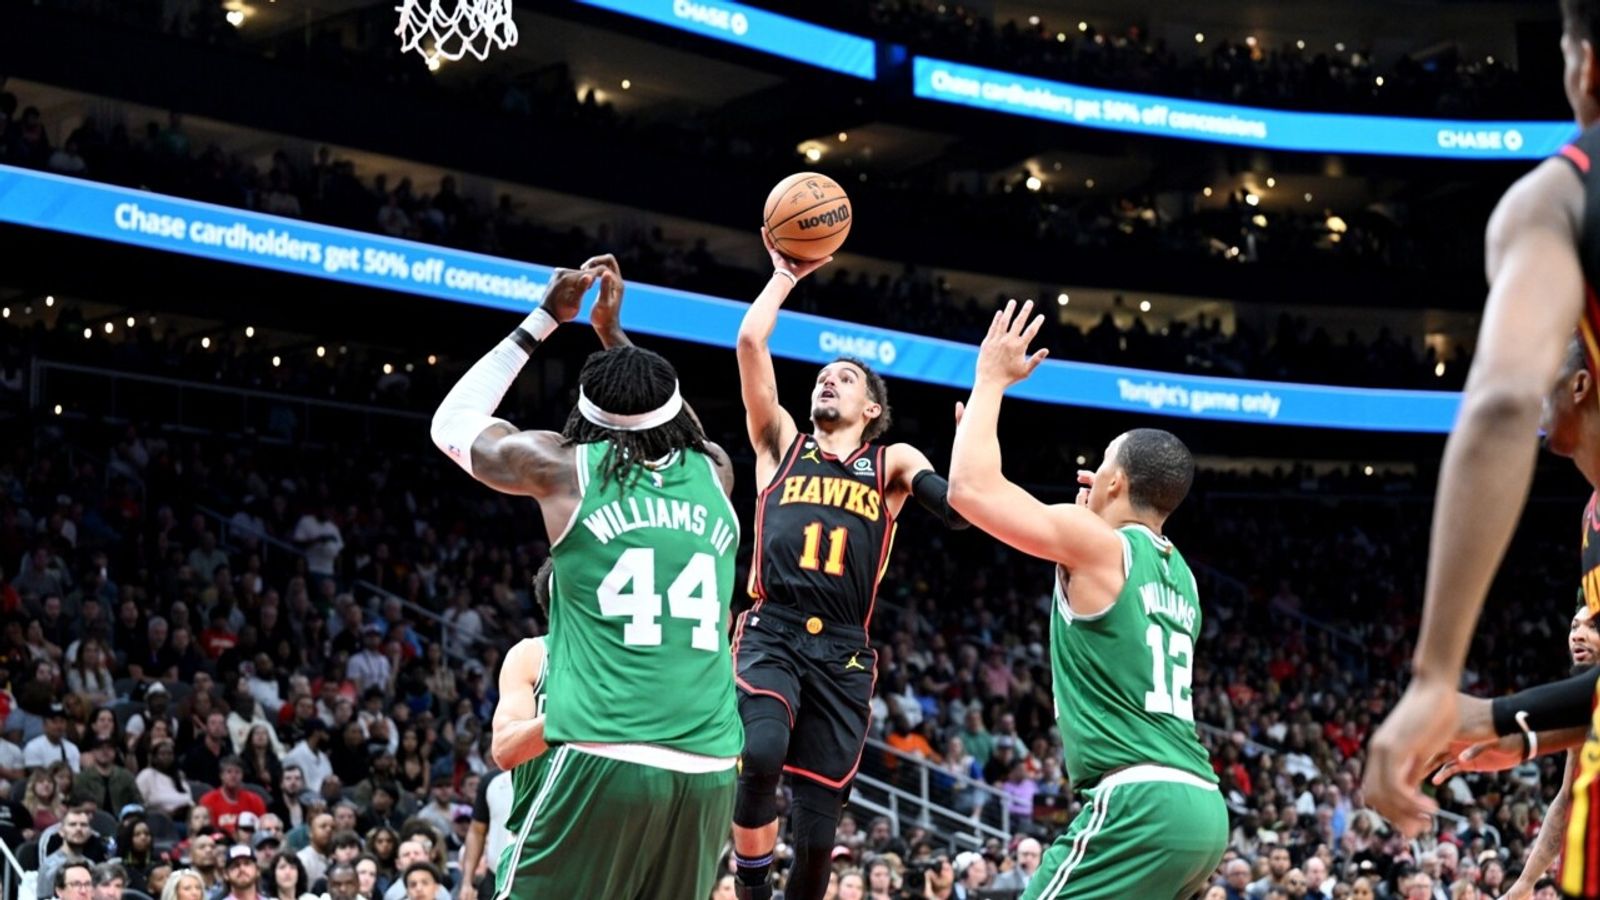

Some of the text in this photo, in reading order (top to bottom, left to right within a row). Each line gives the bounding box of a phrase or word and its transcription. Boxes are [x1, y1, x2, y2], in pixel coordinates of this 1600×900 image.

[673, 0, 730, 30] CHASE
[931, 70, 1267, 138] Chase cardholders get 50% off concessions
[1437, 129, 1502, 149] CHASE
[797, 204, 850, 230] Wilson
[114, 202, 187, 240] Chase
[189, 221, 322, 264] cardholders
[323, 246, 361, 273] get
[363, 248, 410, 279] 50%
[411, 257, 446, 285] off
[819, 331, 877, 360] CHASE
[1117, 378, 1281, 419] Tonight's game only
[778, 475, 881, 522] HAWKS
[582, 496, 734, 557] WILLIAMS III
[799, 521, 848, 577] 11
[596, 547, 721, 652] 44
[1138, 581, 1196, 632] WILLIAMS
[1144, 623, 1195, 721] 12
